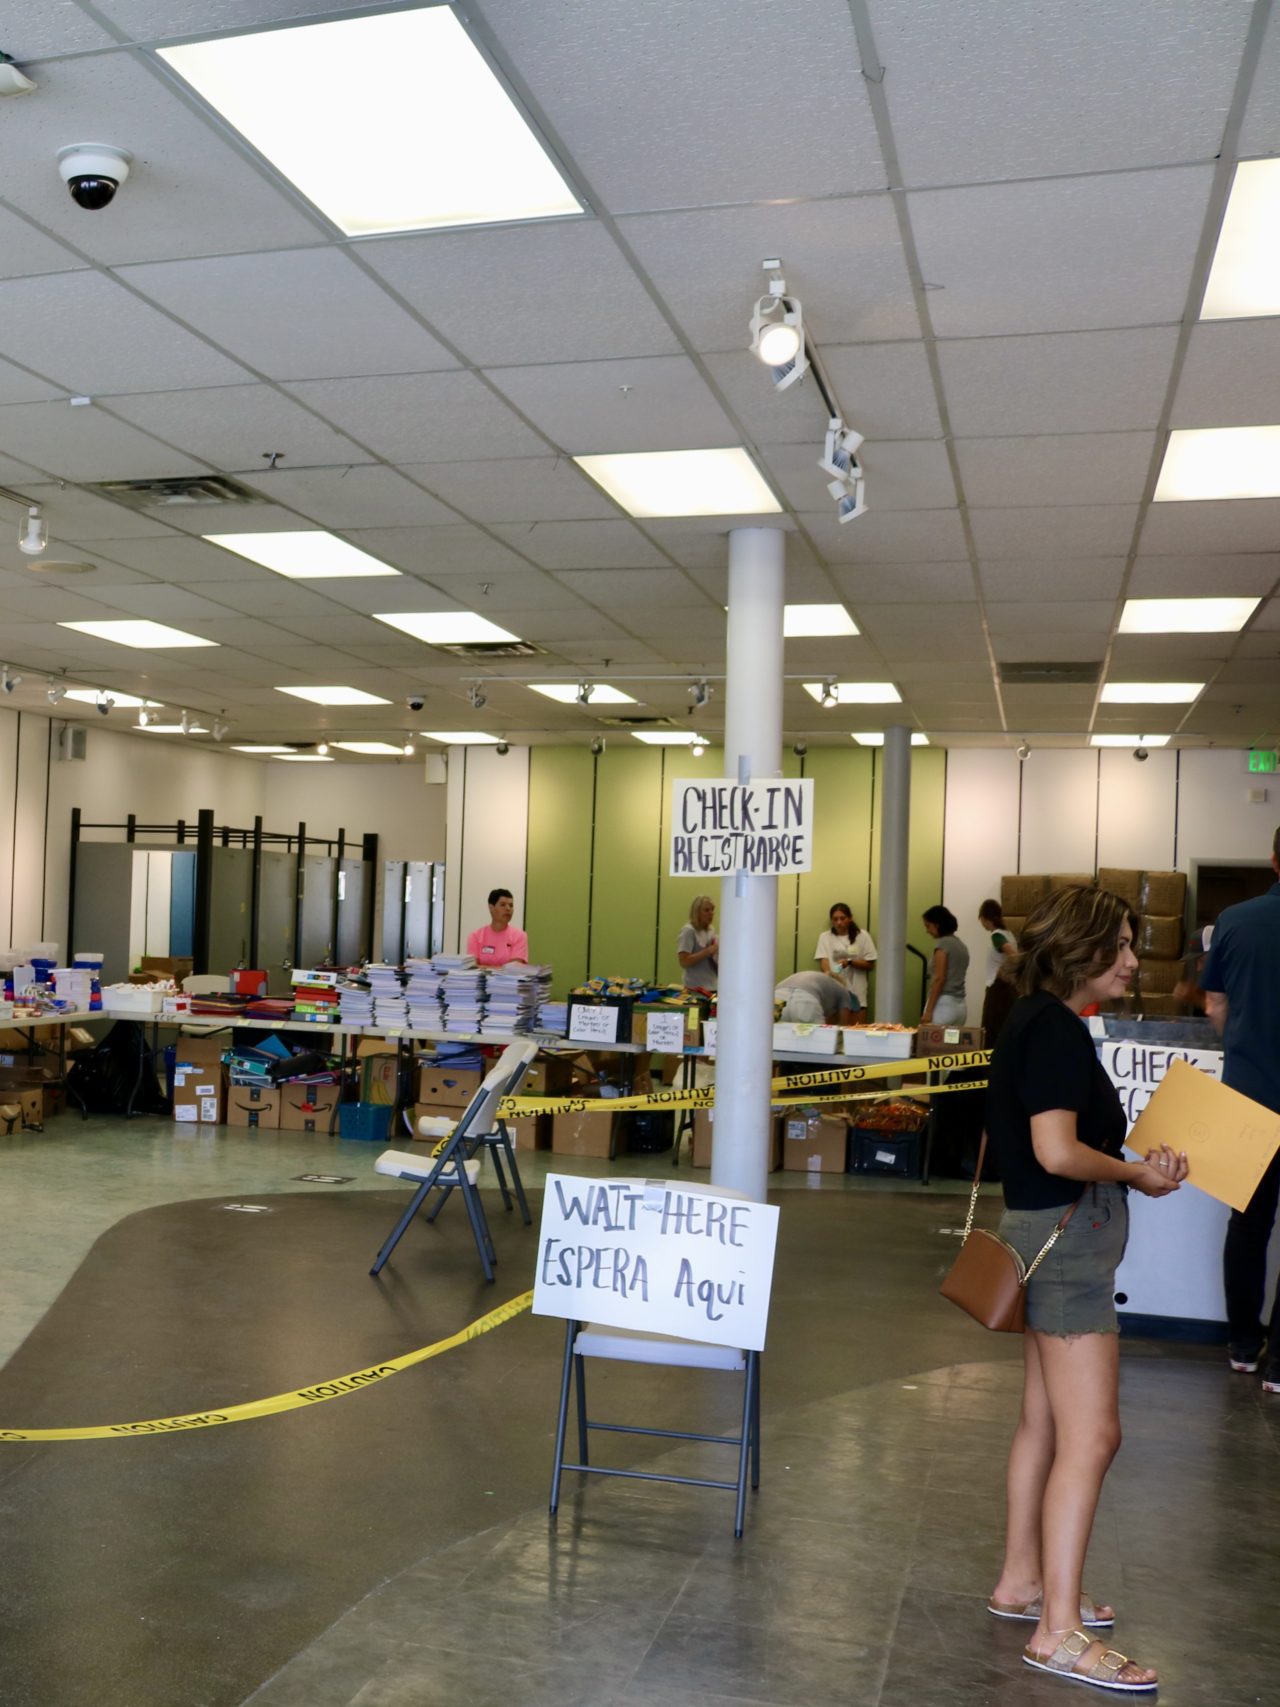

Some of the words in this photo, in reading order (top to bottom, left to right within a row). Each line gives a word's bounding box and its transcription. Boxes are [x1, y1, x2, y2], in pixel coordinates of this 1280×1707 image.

[674, 833, 804, 874] REGISTRARSE
[928, 1050, 992, 1070] AUTION
[786, 1067, 866, 1088] CAUTION
[948, 1081, 986, 1091] TION
[554, 1180, 644, 1232] WAIT
[660, 1191, 751, 1247] HERE
[542, 1238, 649, 1303] ESPERA
[297, 1365, 398, 1402] CAUTION
[110, 1413, 229, 1435] CAUTION
